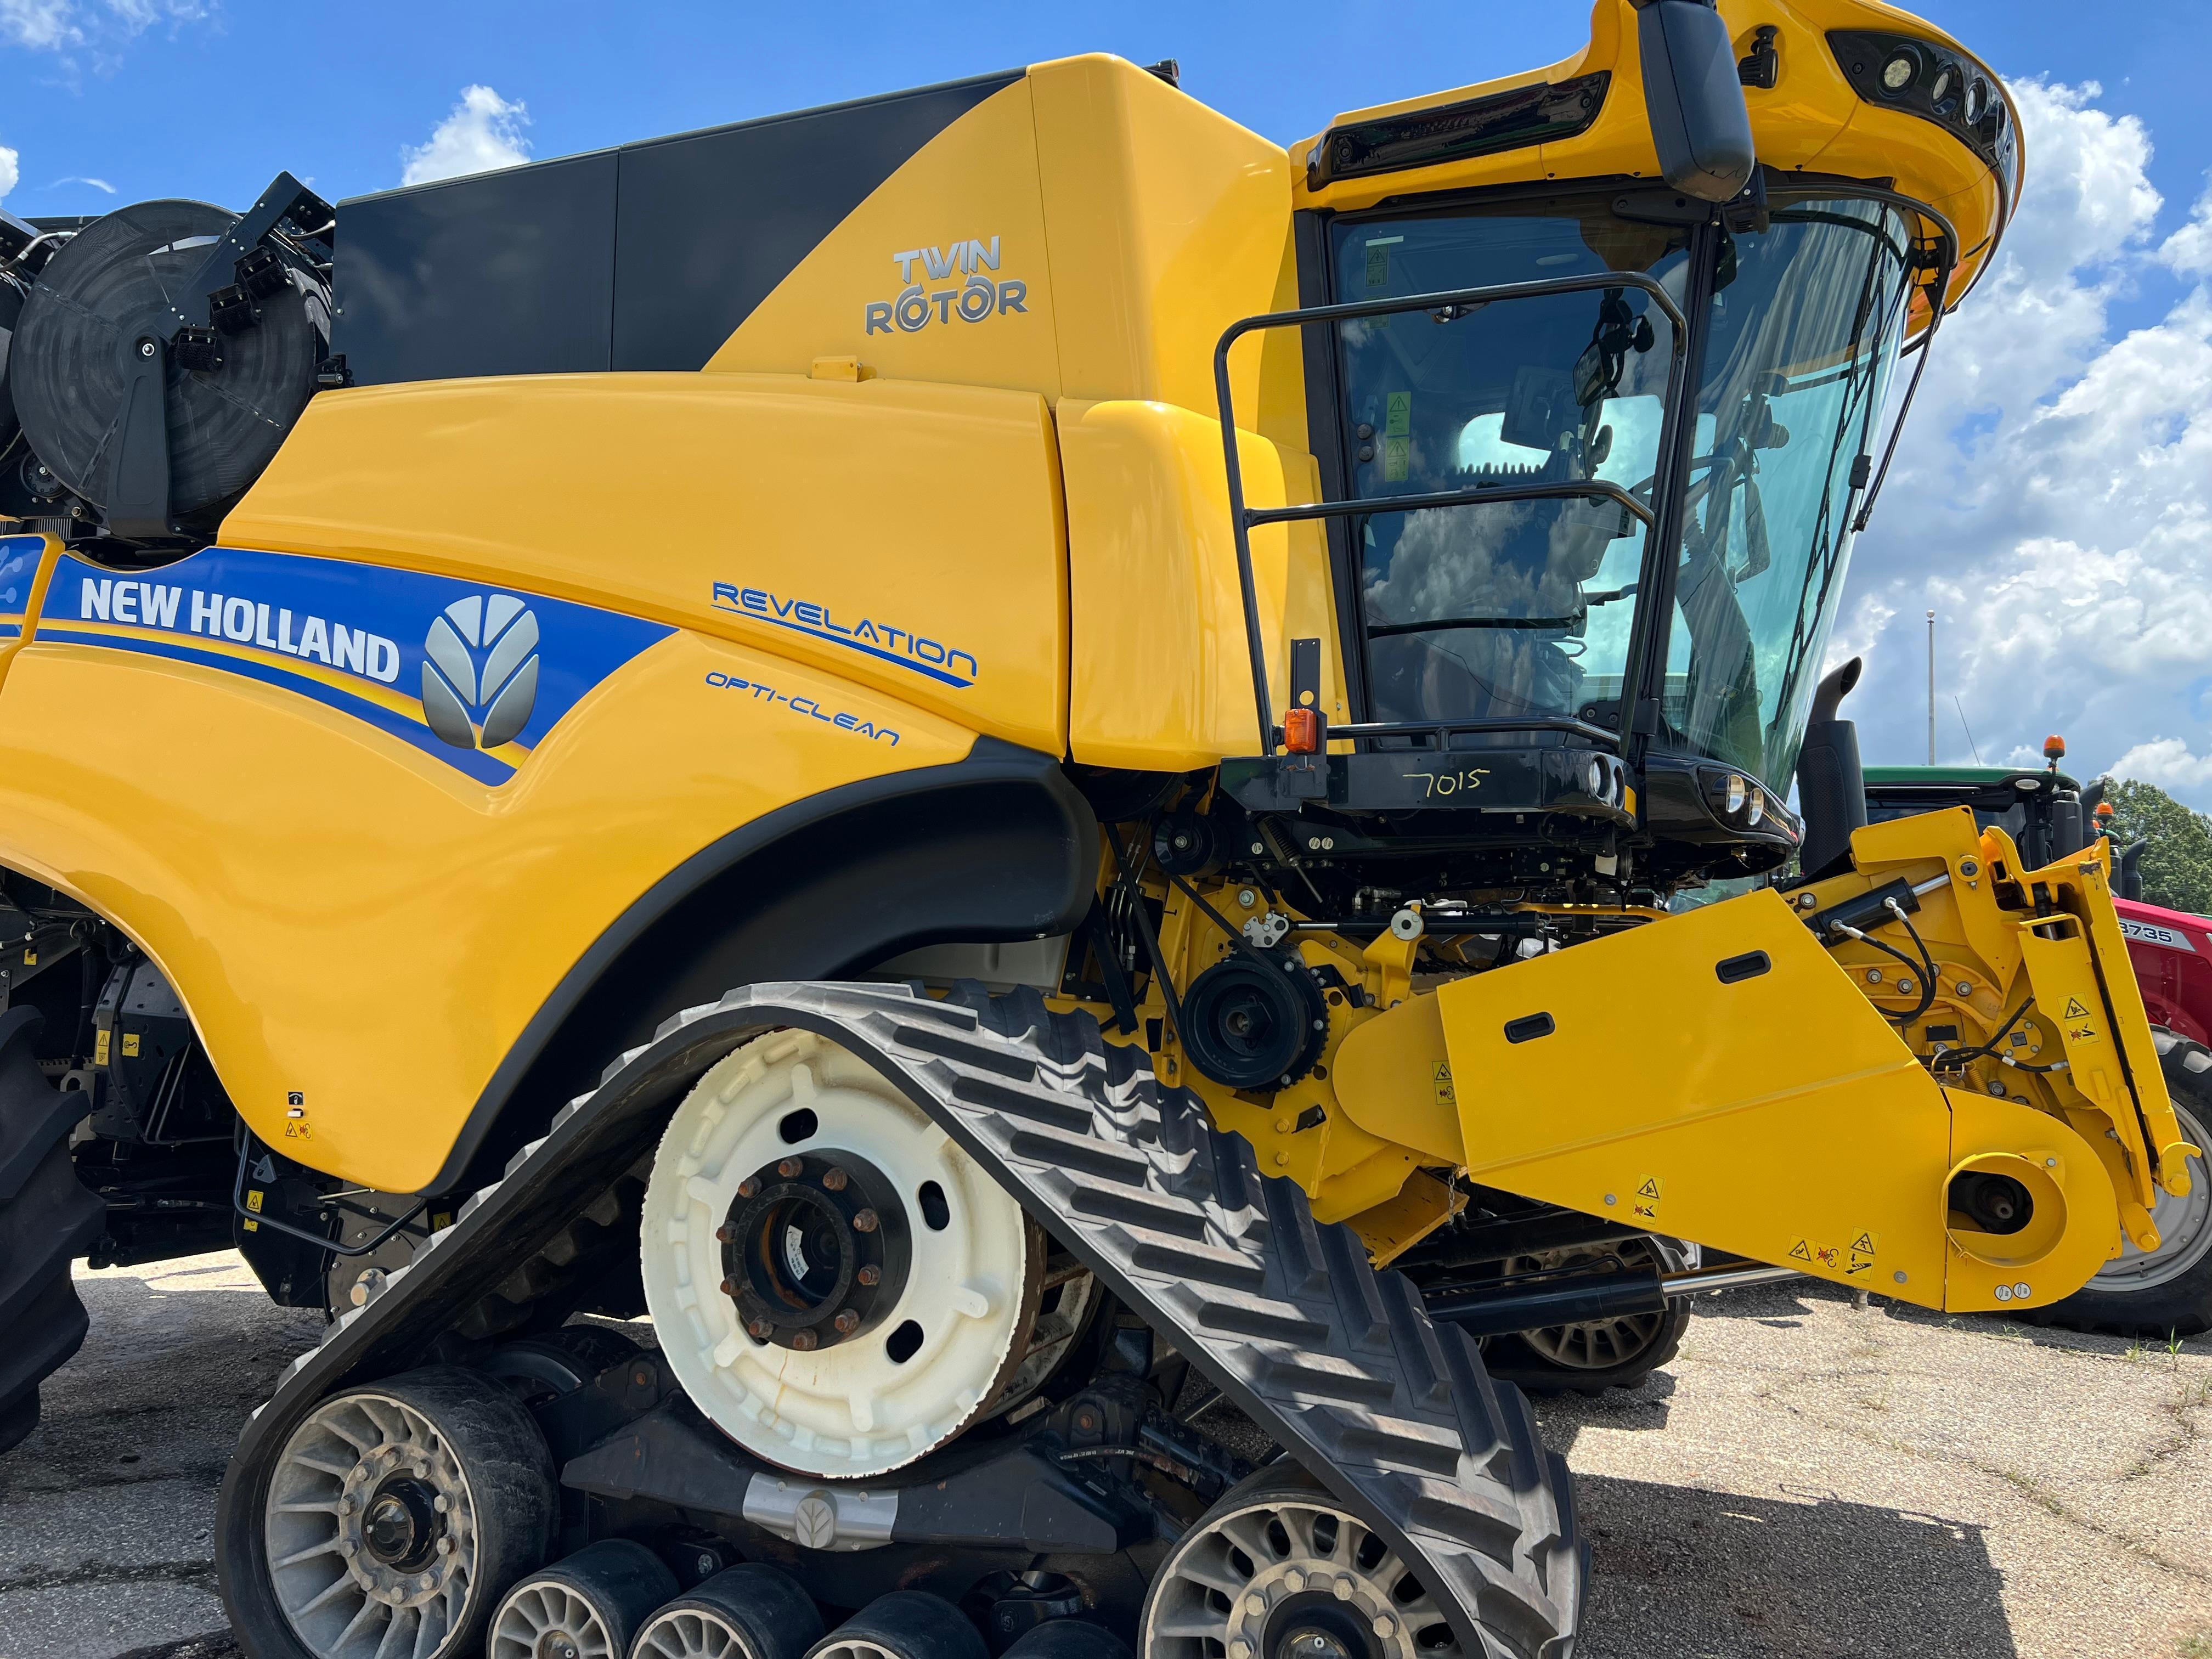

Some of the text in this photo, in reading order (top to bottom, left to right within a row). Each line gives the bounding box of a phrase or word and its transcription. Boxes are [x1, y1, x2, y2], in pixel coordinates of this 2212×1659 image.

[894, 235, 1000, 284] TWIN
[866, 274, 1029, 335] ROTOR
[81, 578, 400, 684] NEW HOLLAND
[713, 580, 977, 677] REVELATION
[705, 672, 900, 747] OPTI-CLEAN
[1402, 768, 1491, 797] 7015
